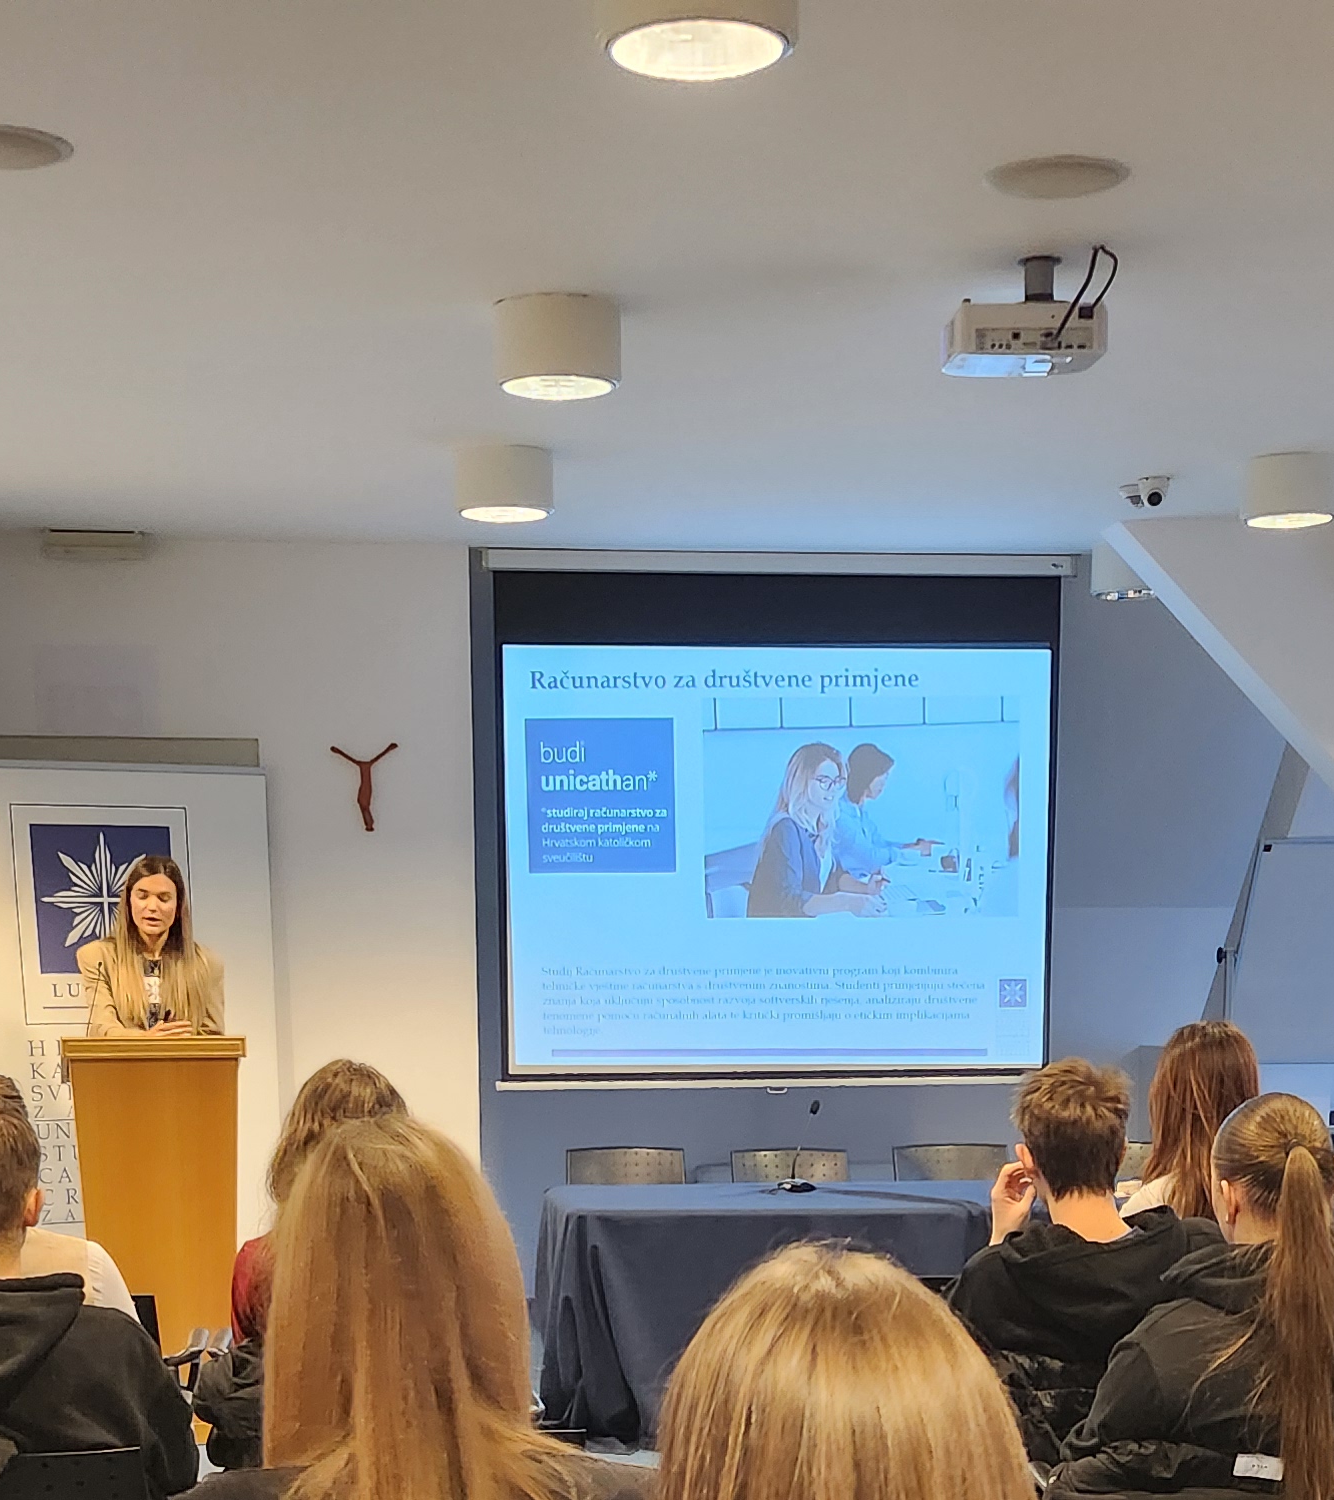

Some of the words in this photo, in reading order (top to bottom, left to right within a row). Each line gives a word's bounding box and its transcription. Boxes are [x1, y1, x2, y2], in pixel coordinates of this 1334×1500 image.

[530, 669, 666, 690] Računarstvo
[673, 674, 696, 689] za
[704, 668, 812, 690] društvene
[819, 668, 919, 694] primjene
[540, 740, 586, 764] budi
[589, 807, 654, 818] računarstvo
[655, 808, 668, 818] za
[541, 822, 596, 833] društvene
[597, 823, 646, 835] primjene
[647, 824, 660, 833] na
[542, 837, 596, 848] Hrvatskom
[598, 837, 652, 848] katoličkom
[52, 982, 80, 998] LU
[28, 1039, 61, 1057] H
[30, 1061, 62, 1080] KA
[36, 1121, 71, 1141] UN
[39, 1166, 73, 1185] CA
[44, 1187, 80, 1207] CR
[42, 1208, 76, 1223] ZA
